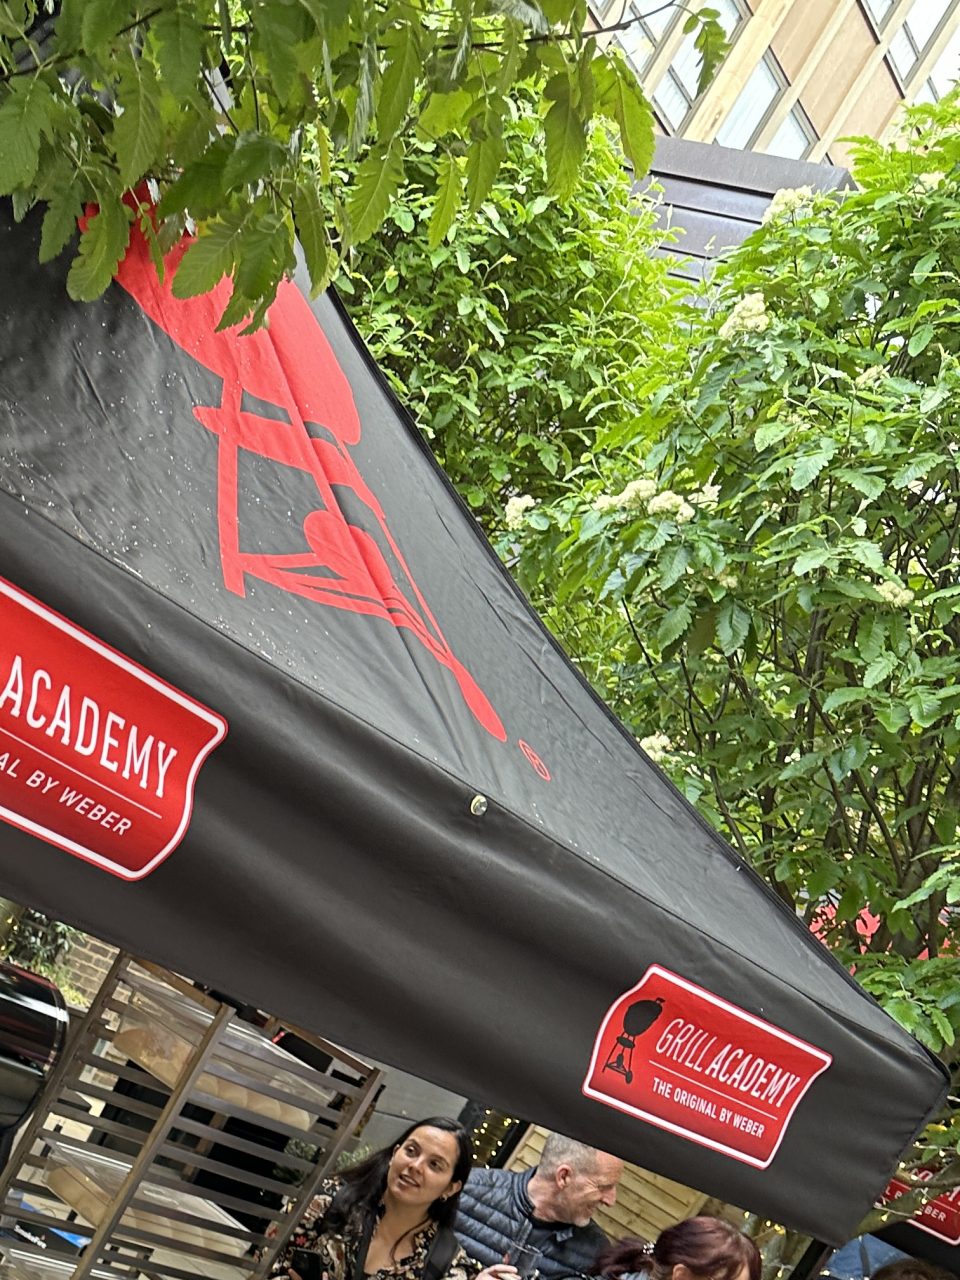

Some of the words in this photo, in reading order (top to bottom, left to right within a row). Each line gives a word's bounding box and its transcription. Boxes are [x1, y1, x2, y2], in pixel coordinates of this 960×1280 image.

[25, 769, 58, 795] BY
[58, 787, 133, 837] WEBER
[655, 1018, 716, 1072] GRILL
[704, 1043, 801, 1108] ACADEMY
[652, 1077, 672, 1099] THE
[673, 1087, 717, 1119] ORIGINAL
[719, 1107, 733, 1125] BY
[733, 1113, 766, 1139] WEBER
[919, 1205, 947, 1222] BER
